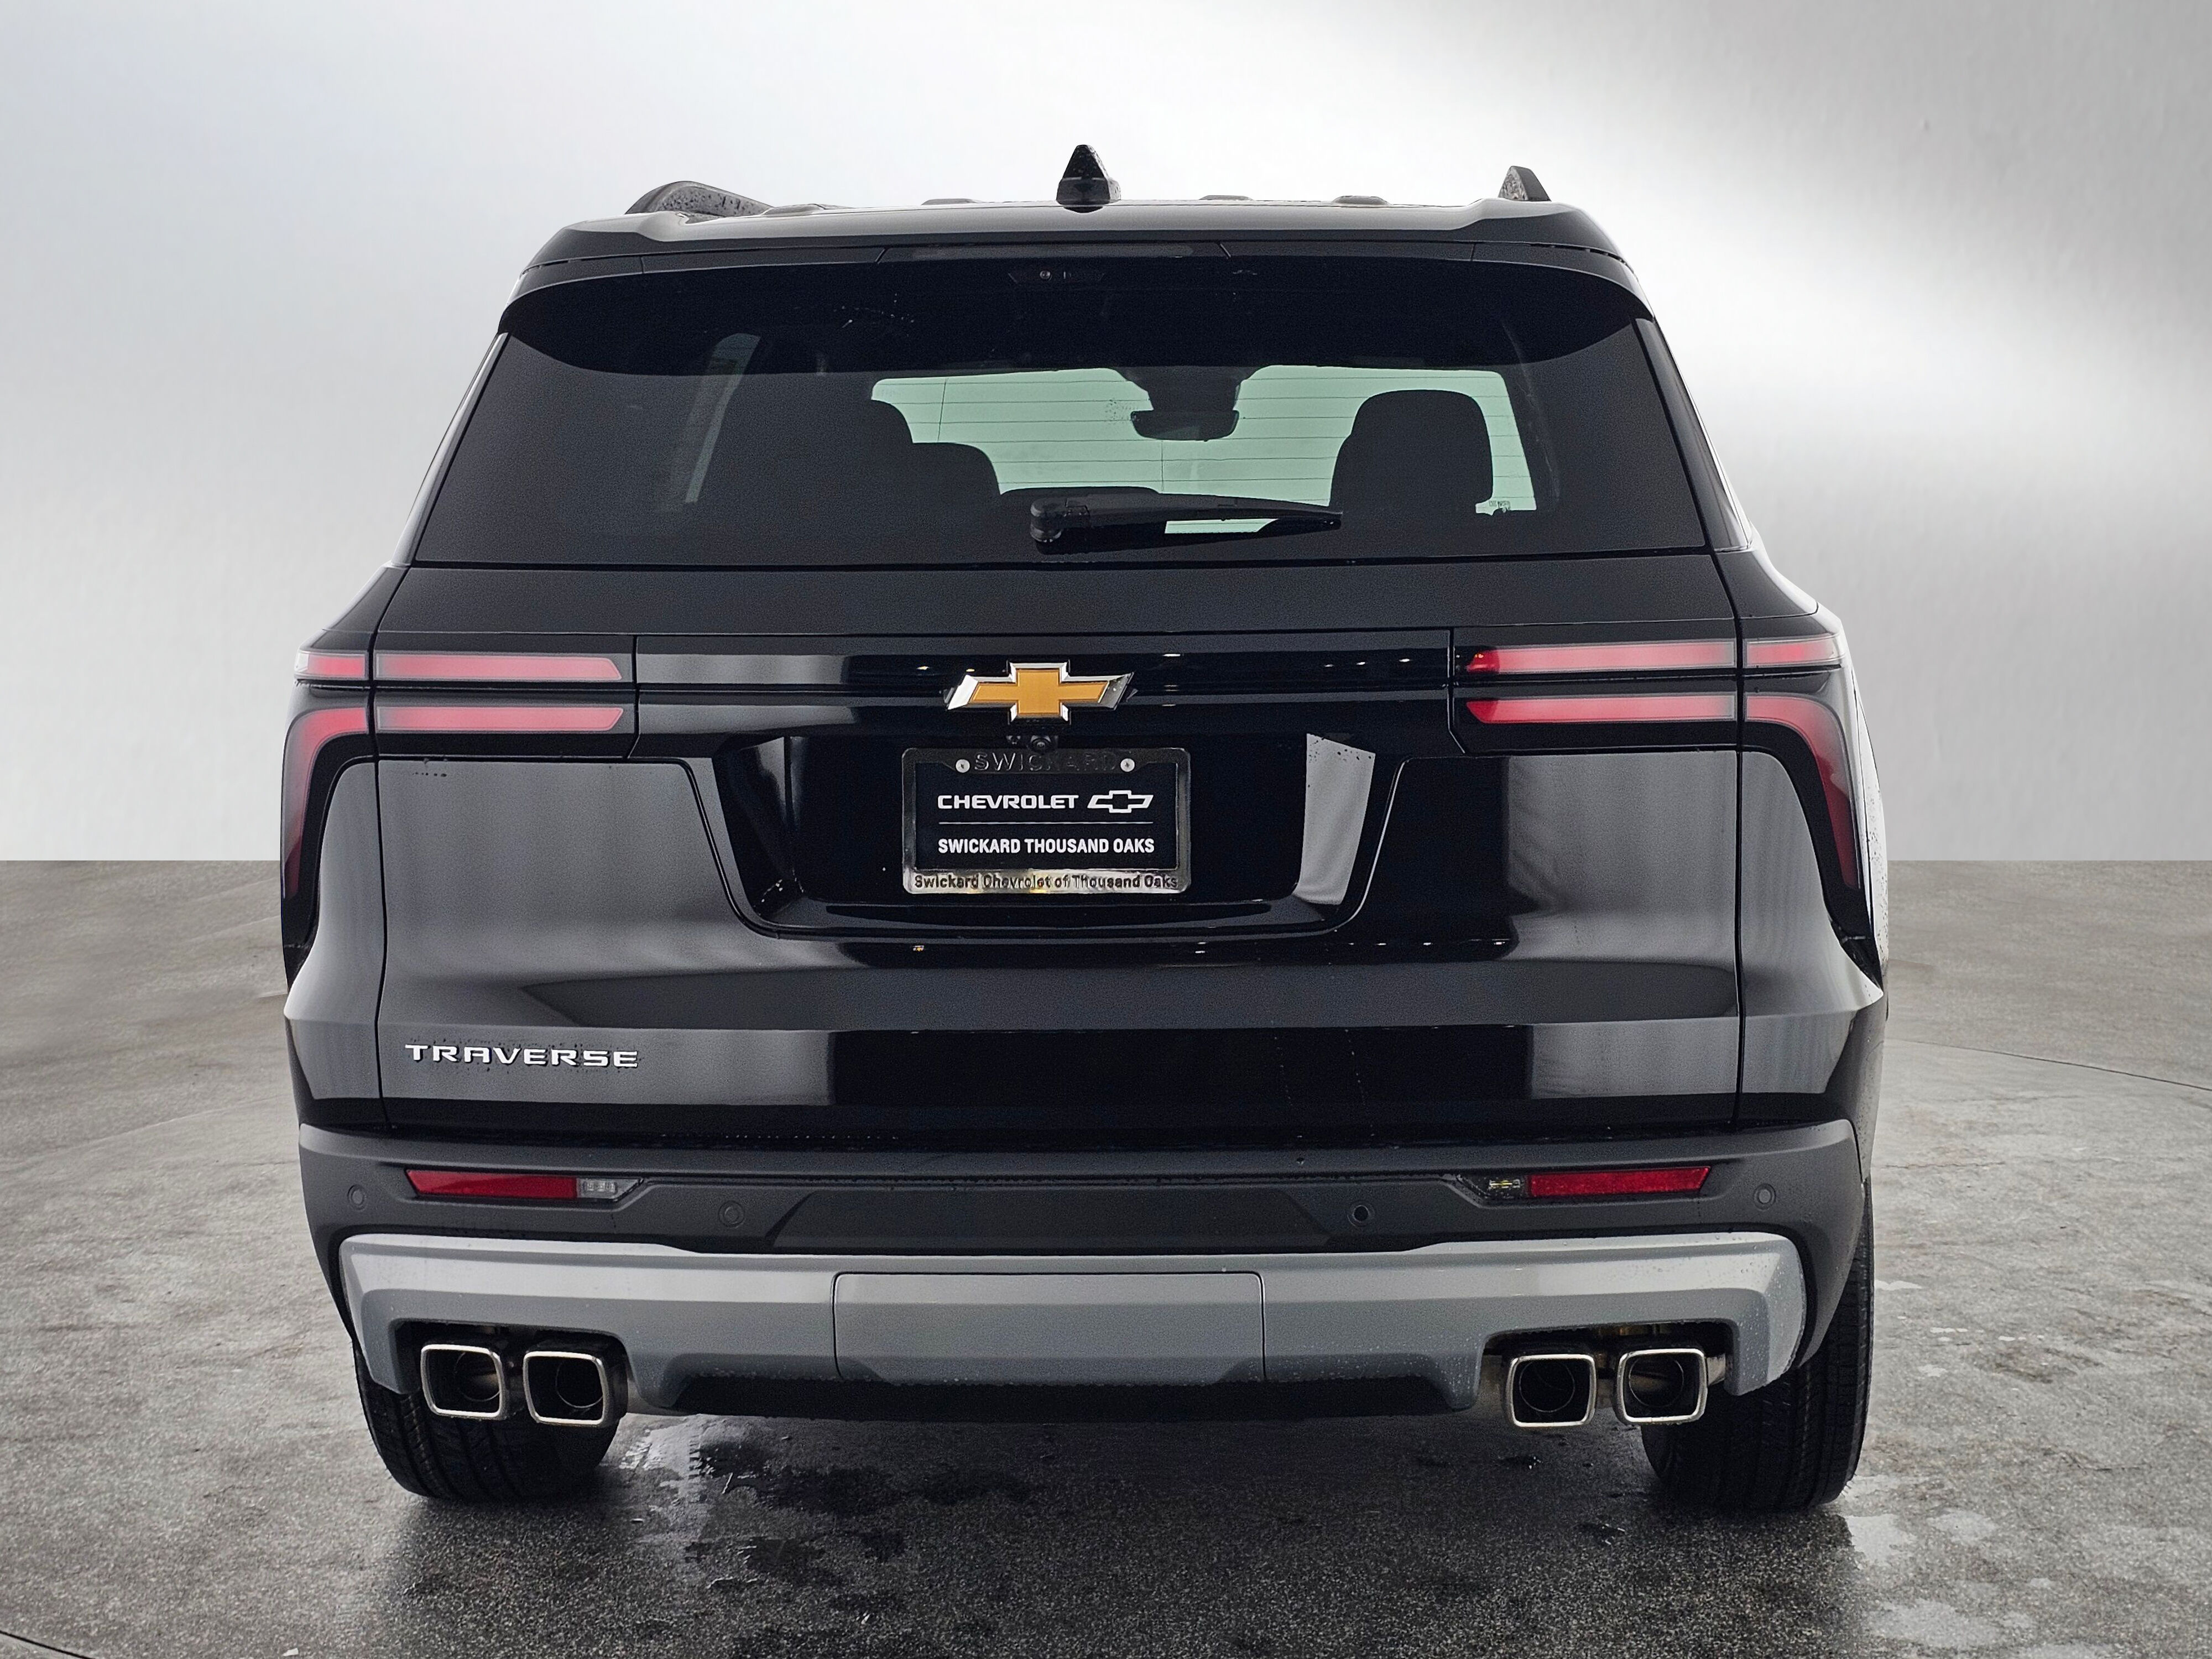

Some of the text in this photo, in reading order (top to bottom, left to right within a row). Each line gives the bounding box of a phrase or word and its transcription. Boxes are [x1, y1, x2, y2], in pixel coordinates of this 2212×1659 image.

[938, 795, 1079, 809] CHEVROLET
[938, 838, 1155, 853] SWICKARD THOUSAND OAKS
[915, 873, 1177, 889] Swickard Chevrolet of Thousand Oaks
[405, 1044, 638, 1068] TRAVERSE
